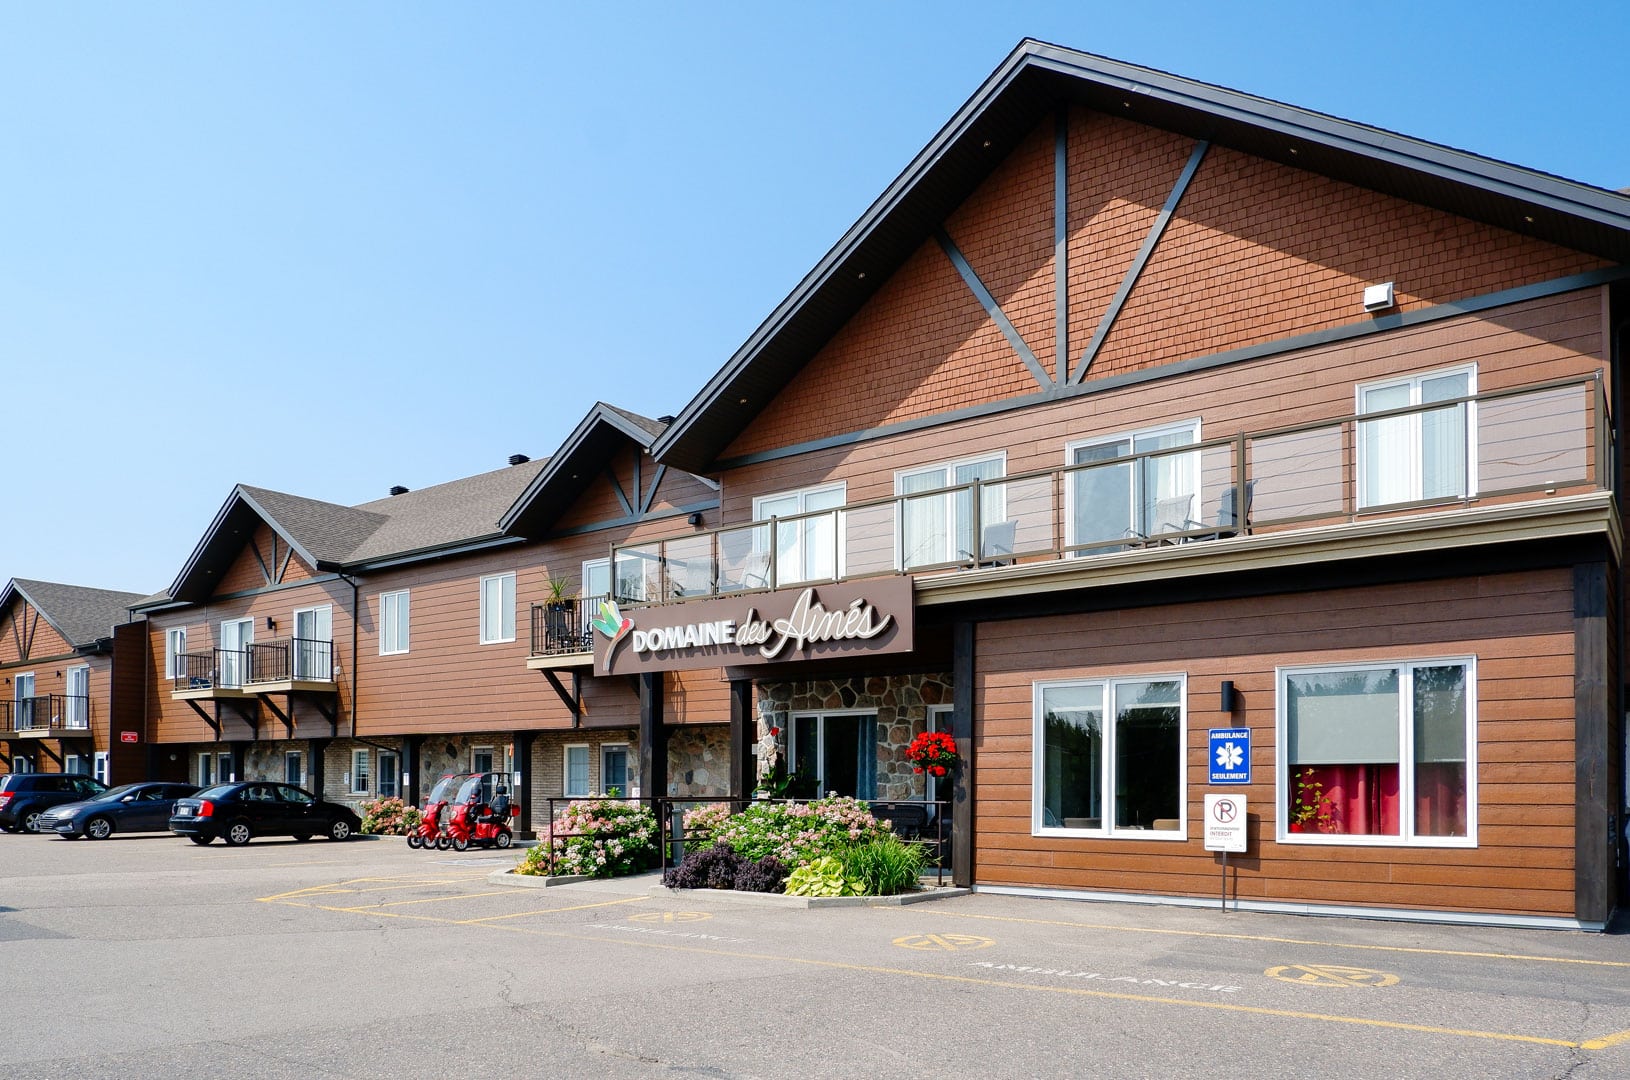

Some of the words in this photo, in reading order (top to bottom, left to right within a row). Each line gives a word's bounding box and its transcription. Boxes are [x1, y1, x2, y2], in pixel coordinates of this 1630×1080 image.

[633, 620, 736, 653] DOMAINE
[735, 608, 772, 647] des
[760, 588, 891, 659] Aînés
